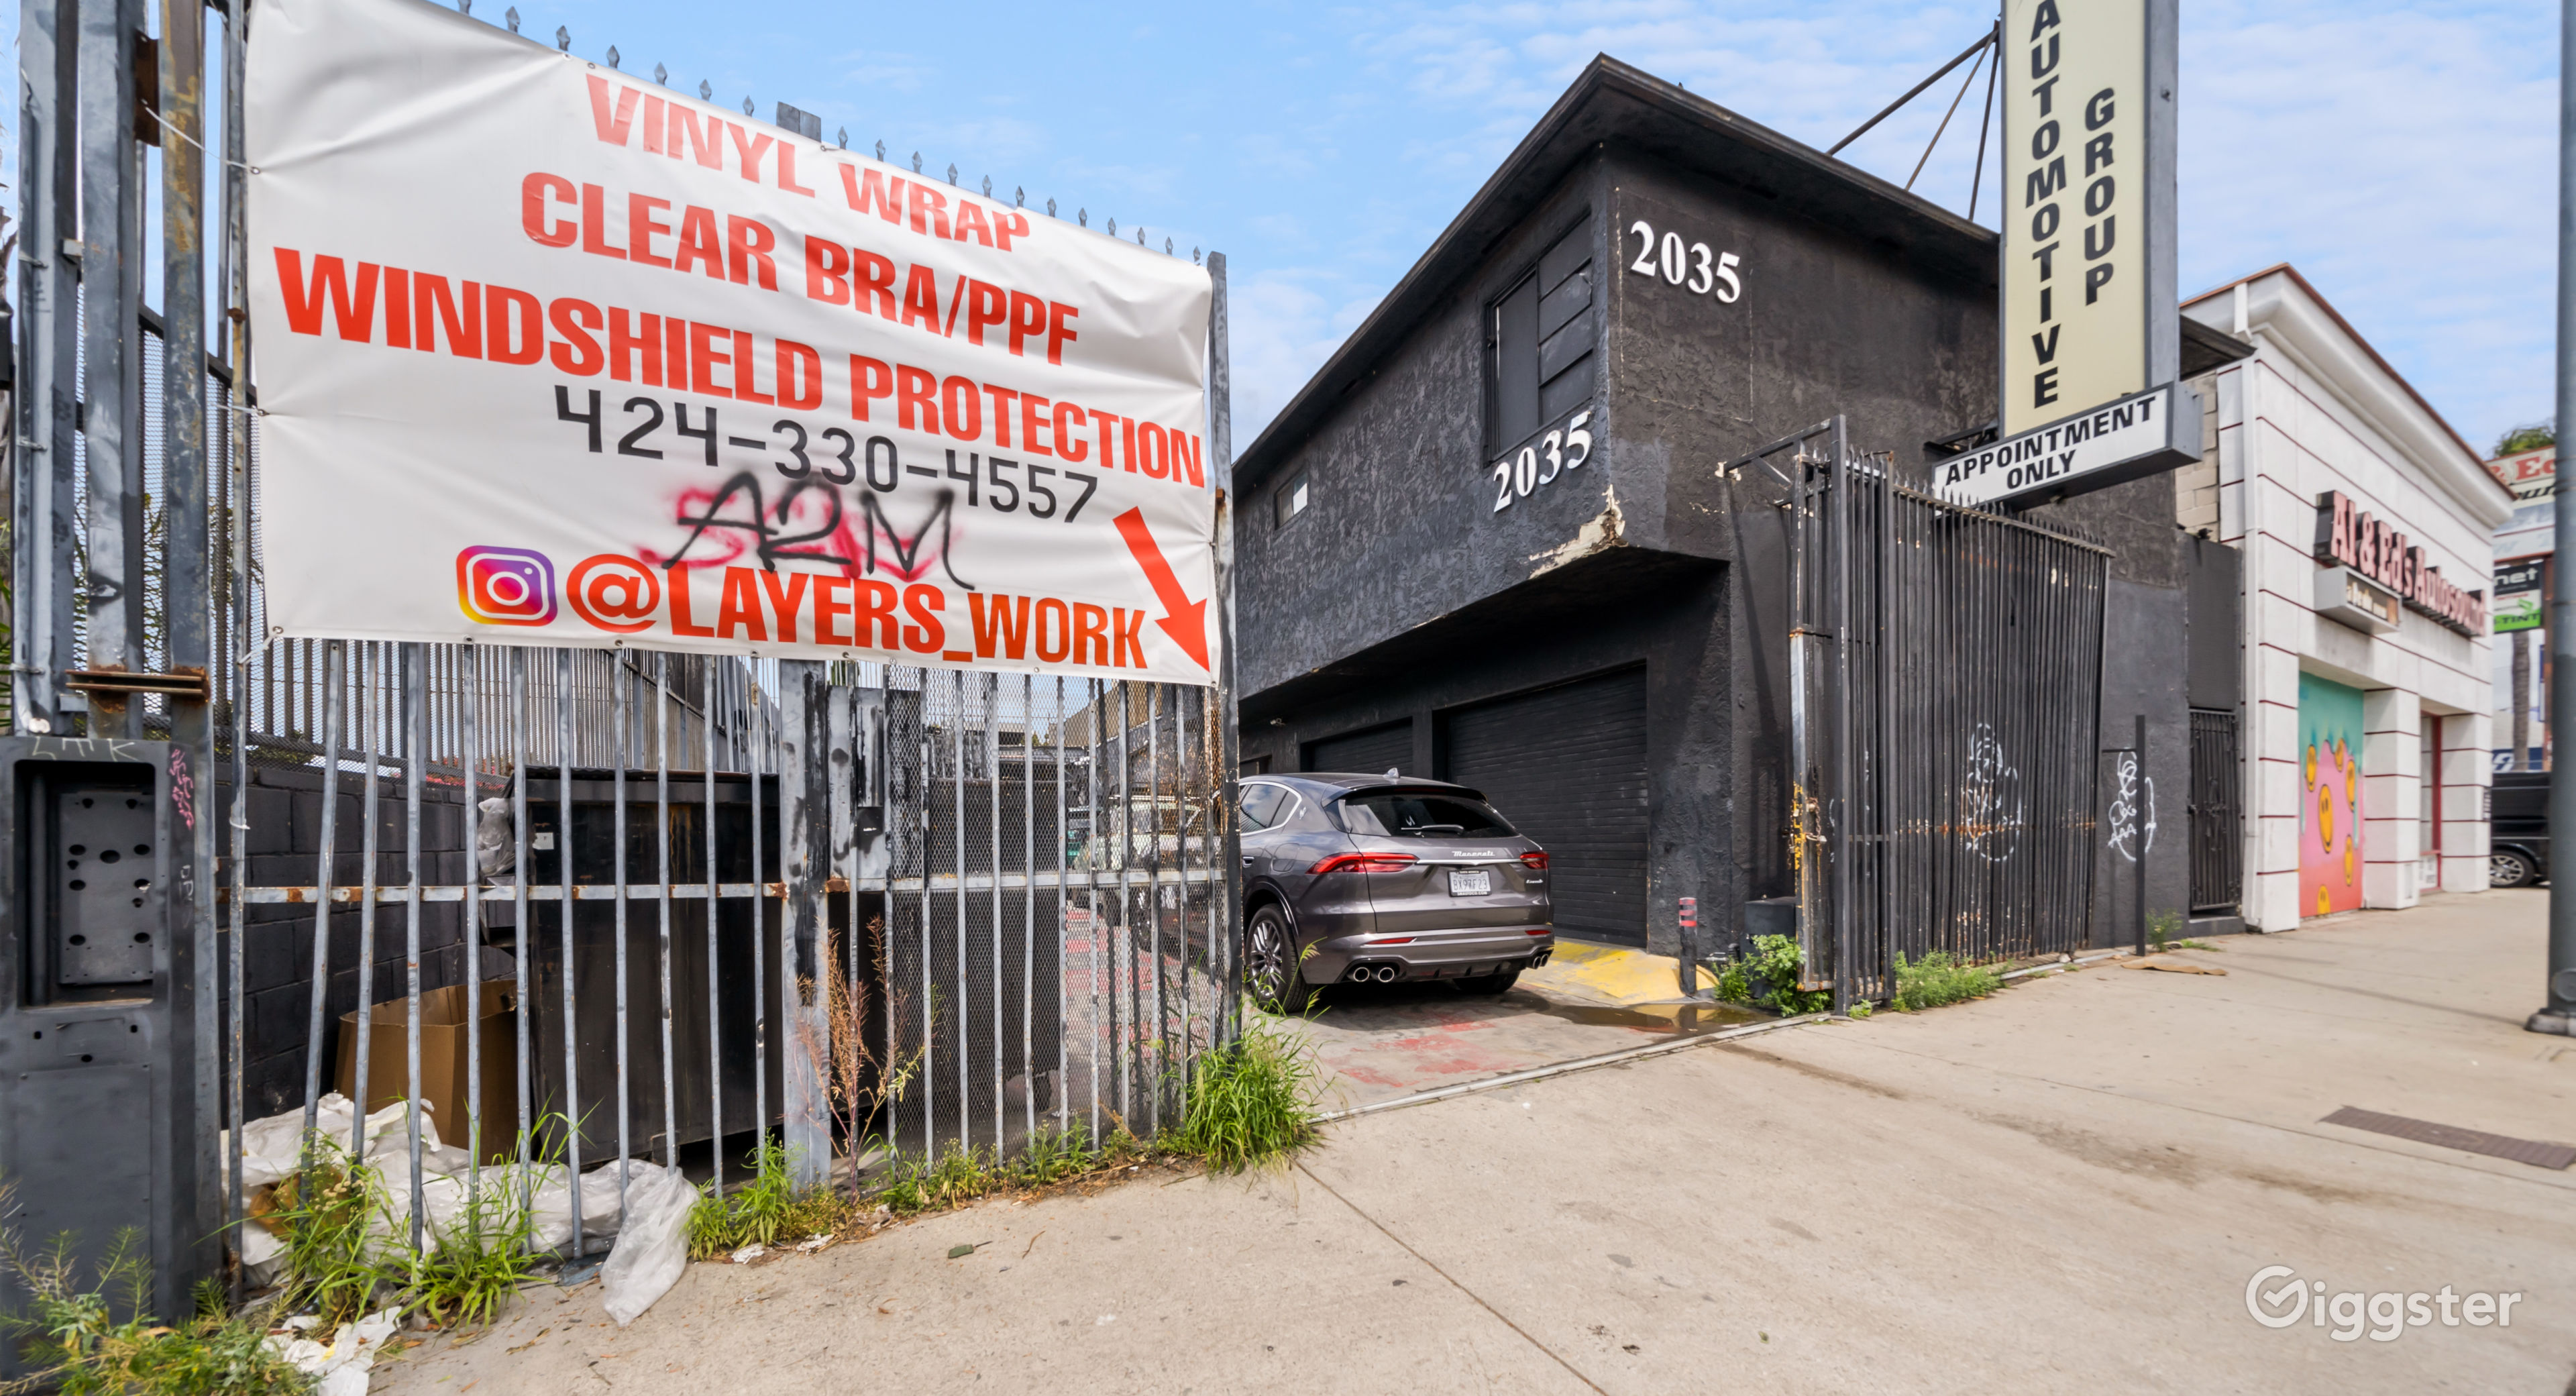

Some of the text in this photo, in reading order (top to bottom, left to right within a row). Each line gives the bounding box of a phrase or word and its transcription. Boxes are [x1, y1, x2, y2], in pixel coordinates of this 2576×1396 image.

[586, 74, 1030, 252] VINYL WRAP
[2026, 0, 2066, 409] AUTOMOTIVE
[2085, 88, 2114, 306] GROUP
[522, 172, 1079, 366] CLEAR BRA/PPF
[1631, 220, 1741, 303] 2035
[273, 246, 1205, 489] WINDSHIELD PROTECTION
[554, 385, 1097, 523] 424-330-4557
[1493, 410, 1593, 513] 2035
[1945, 396, 2156, 486] APPOINTMENT
[2006, 449, 2076, 489] ONLY
[2359, 511, 2377, 578] &
[566, 553, 1148, 669] @LAYERS_WORK
